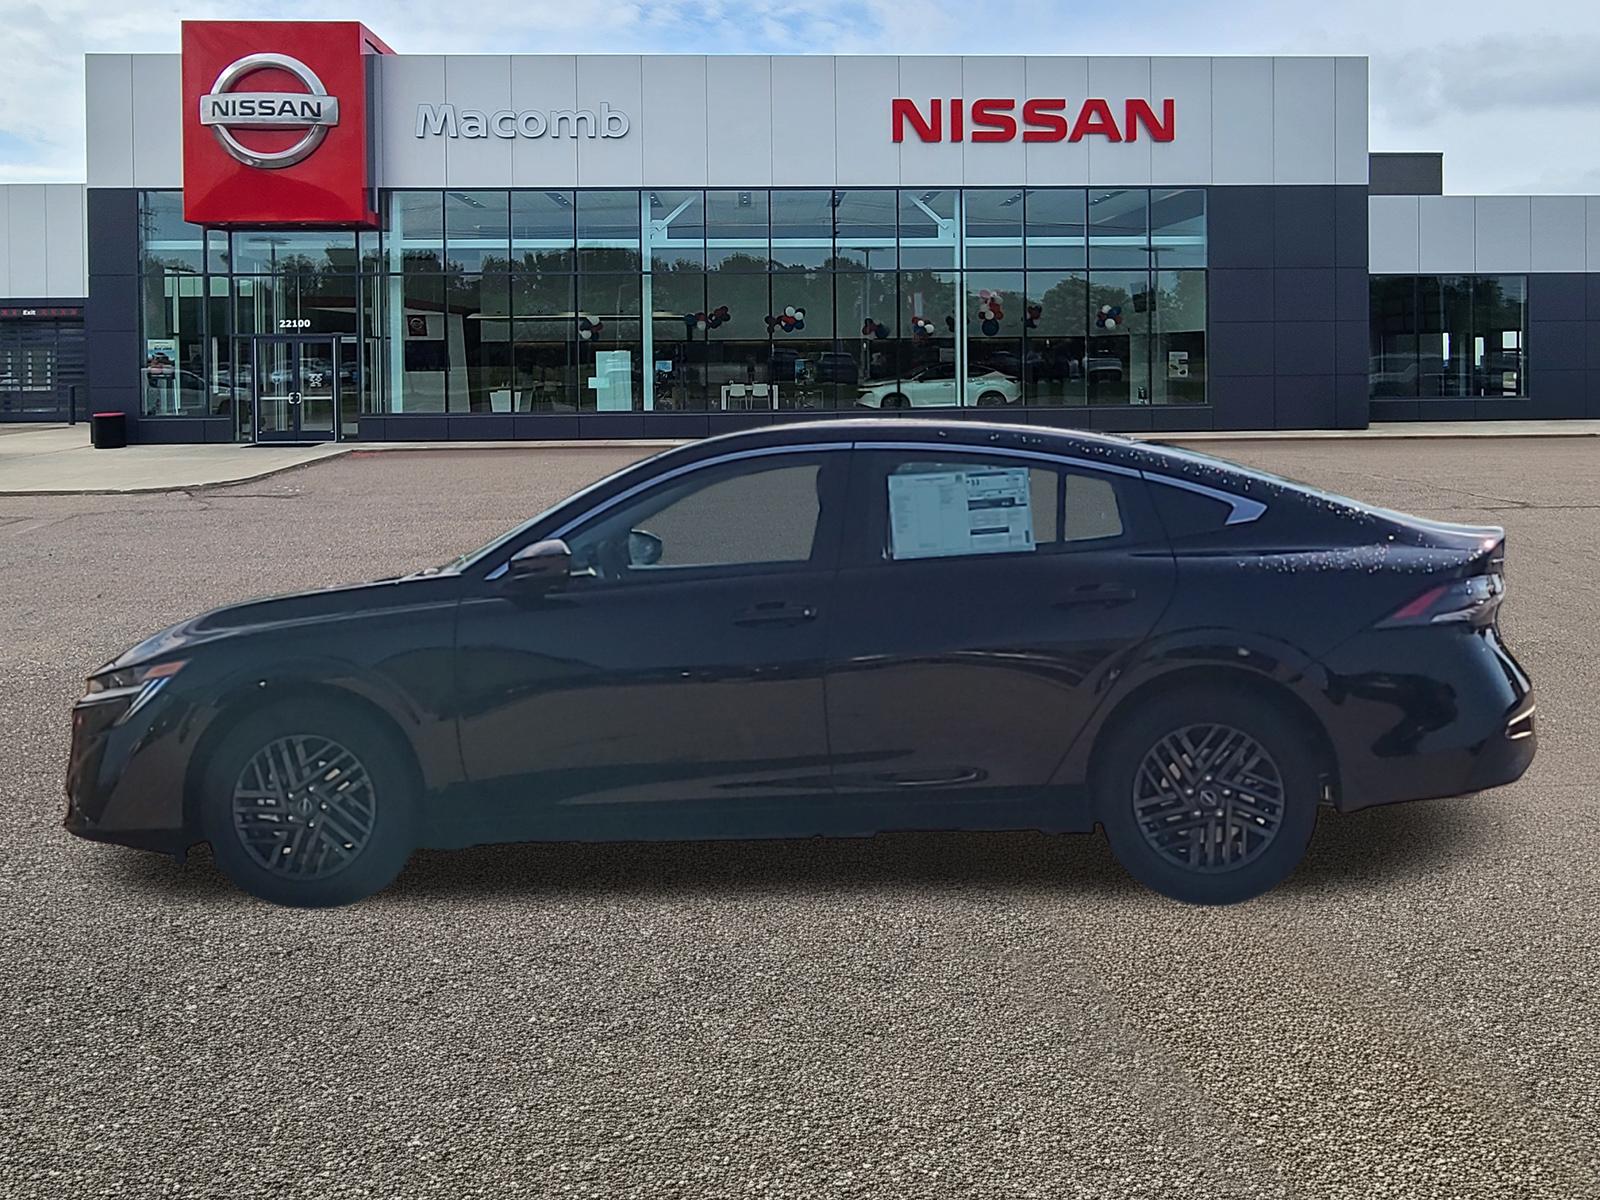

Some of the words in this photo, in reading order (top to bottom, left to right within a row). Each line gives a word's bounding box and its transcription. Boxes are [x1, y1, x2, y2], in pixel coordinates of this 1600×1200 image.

[211, 99, 322, 118] NISSAN
[415, 101, 630, 139] Macomb
[892, 98, 1176, 143] NISSAN
[279, 319, 311, 328] 22100
